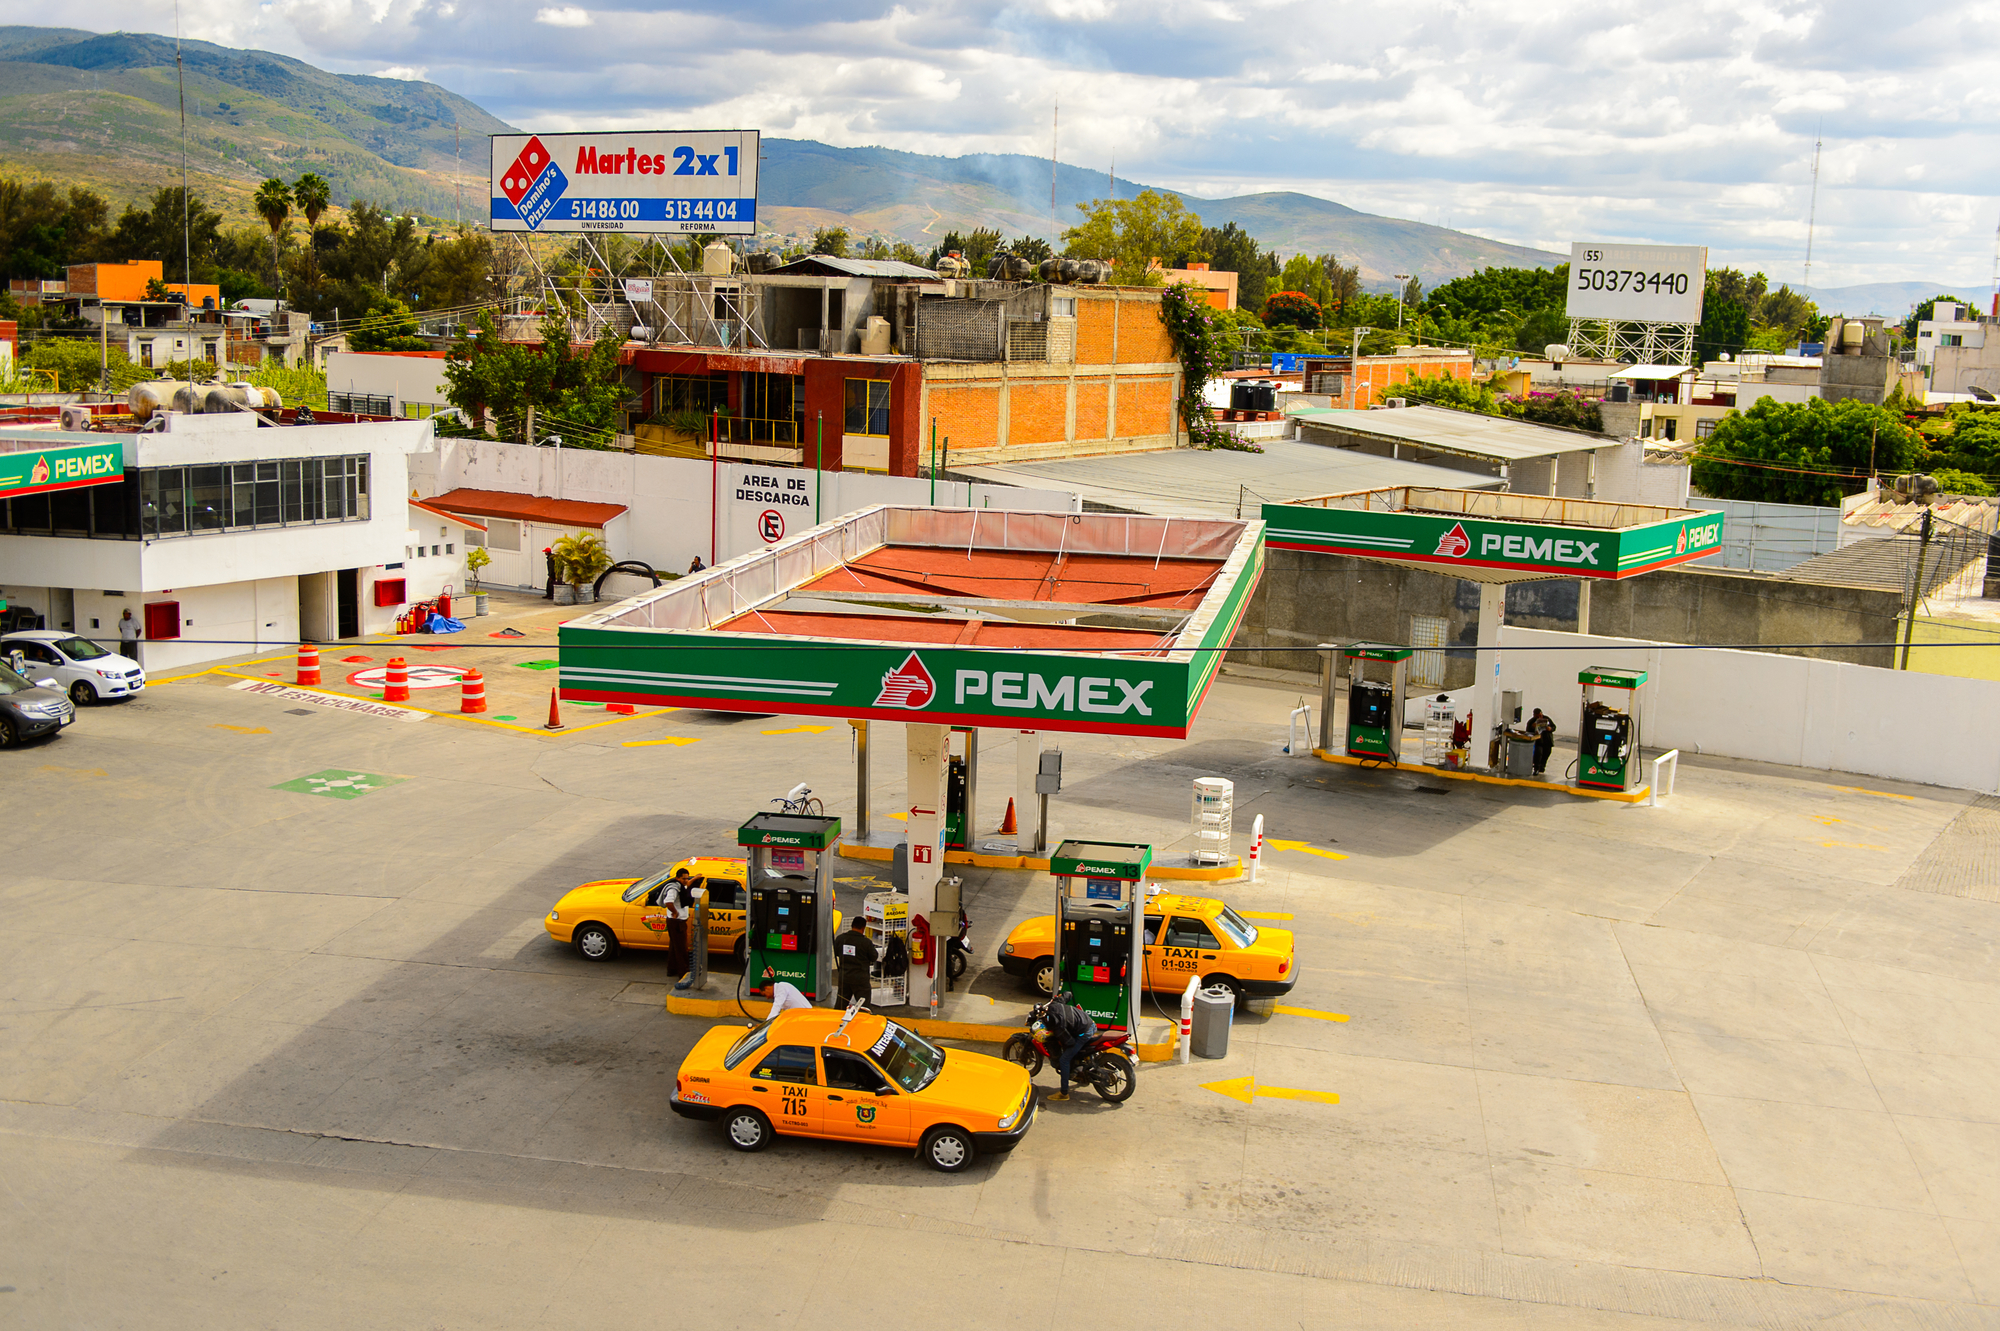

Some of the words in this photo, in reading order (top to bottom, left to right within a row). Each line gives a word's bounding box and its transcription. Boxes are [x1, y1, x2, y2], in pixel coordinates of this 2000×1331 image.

[575, 146, 666, 175] Martes
[672, 146, 739, 176] 2x1
[519, 168, 557, 216] Domino's
[527, 198, 552, 227] Pizza
[680, 223, 716, 231] REFORMA
[1583, 250, 1604, 262] (55)
[1578, 268, 1689, 295] 50373440
[55, 453, 115, 479] PEMEX
[743, 474, 779, 489] AREA
[787, 478, 806, 491] DE
[736, 488, 810, 507] DESCARGA
[1688, 523, 1719, 550] PEMEX
[1481, 533, 1600, 565] PEMEX
[242, 682, 286, 695] NO
[281, 690, 411, 719] ESTACIONARSE
[955, 669, 1154, 717] PEMEX
[771, 836, 801, 844] PEMEX
[808, 835, 822, 847] 11
[1085, 866, 1116, 875] PEMEX
[1122, 865, 1138, 878] 13
[708, 912, 732, 922] AXI
[1163, 947, 1199, 959] TAXI
[1161, 959, 1198, 970] 01-035
[776, 970, 806, 979] PEMEX
[1085, 1009, 1118, 1019] PEMEX
[689, 1075, 711, 1084] SORIANA
[782, 1085, 808, 1098] TAXI
[781, 1097, 807, 1116] 715
